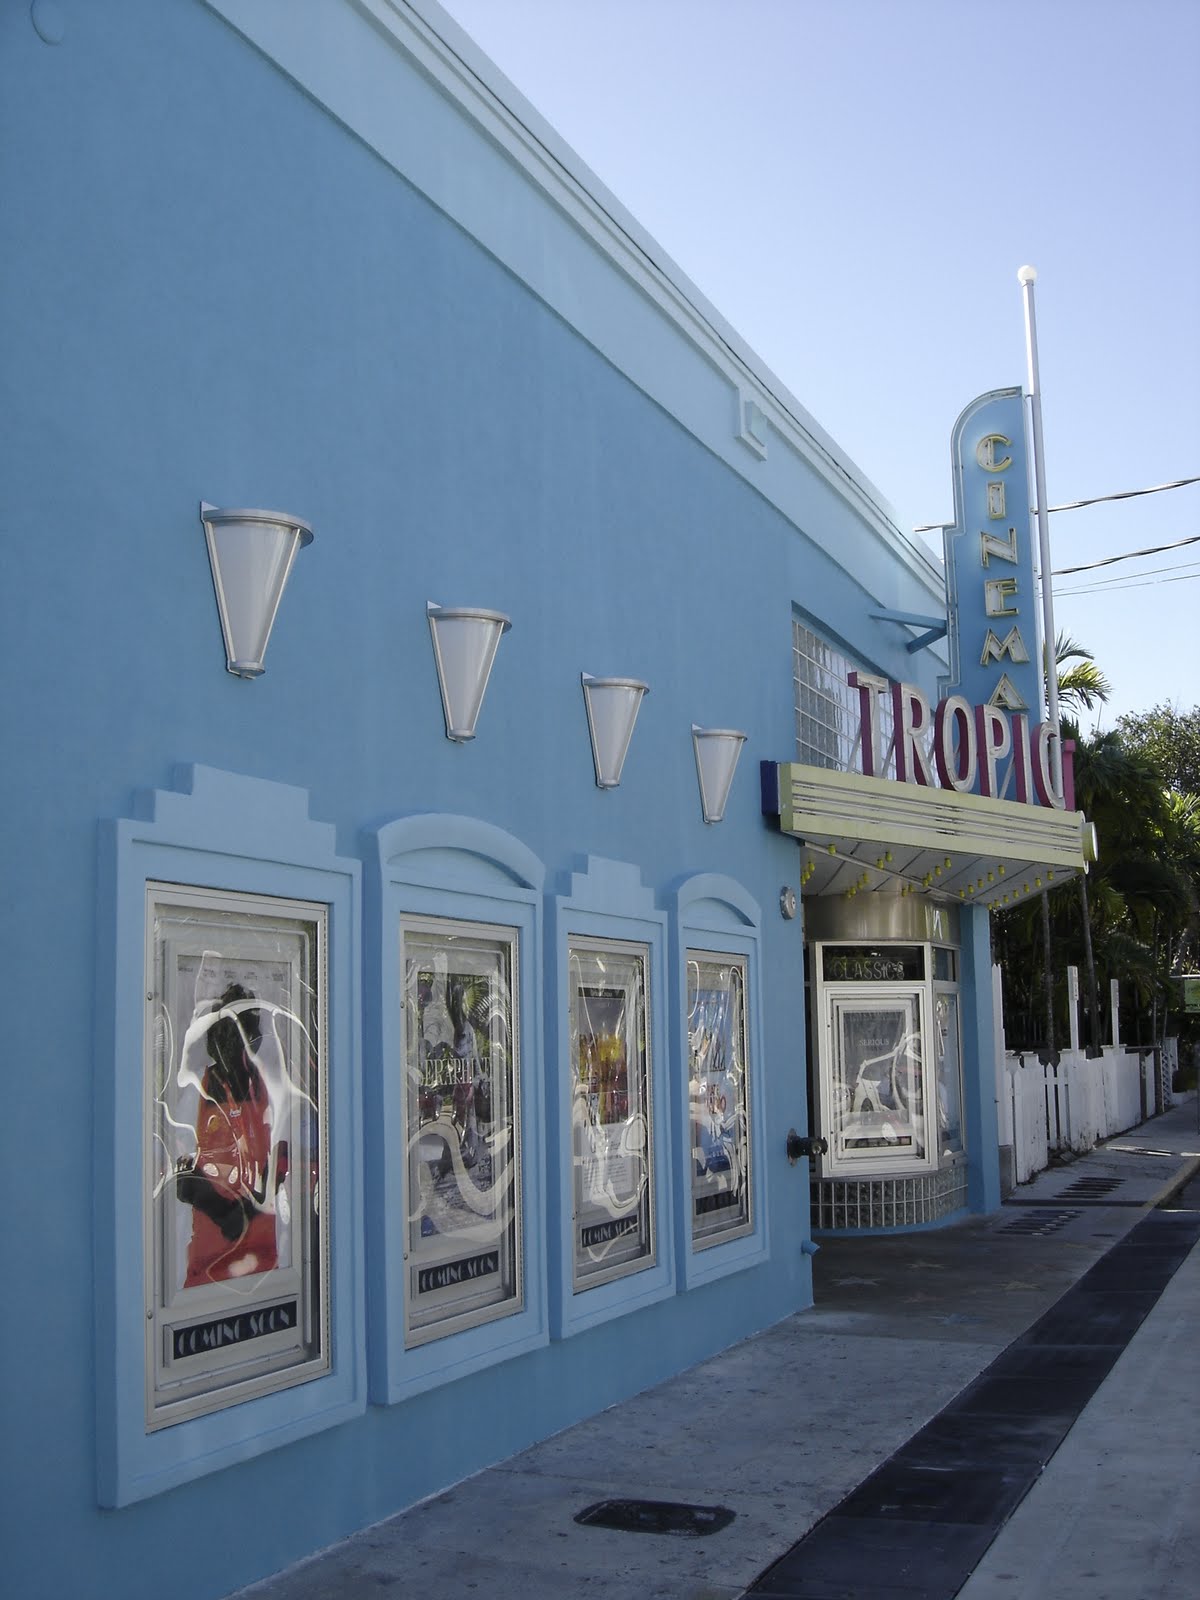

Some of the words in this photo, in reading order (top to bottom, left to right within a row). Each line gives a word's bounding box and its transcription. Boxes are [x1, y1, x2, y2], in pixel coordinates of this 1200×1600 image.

[976, 433, 1029, 710] CINEMA
[847, 671, 1066, 812] TROPIC
[583, 1225, 611, 1246] COMING
[421, 1264, 462, 1291] COMING
[467, 1256, 494, 1278] SOON
[178, 1318, 241, 1355] COMING
[249, 1308, 290, 1337] SOON
